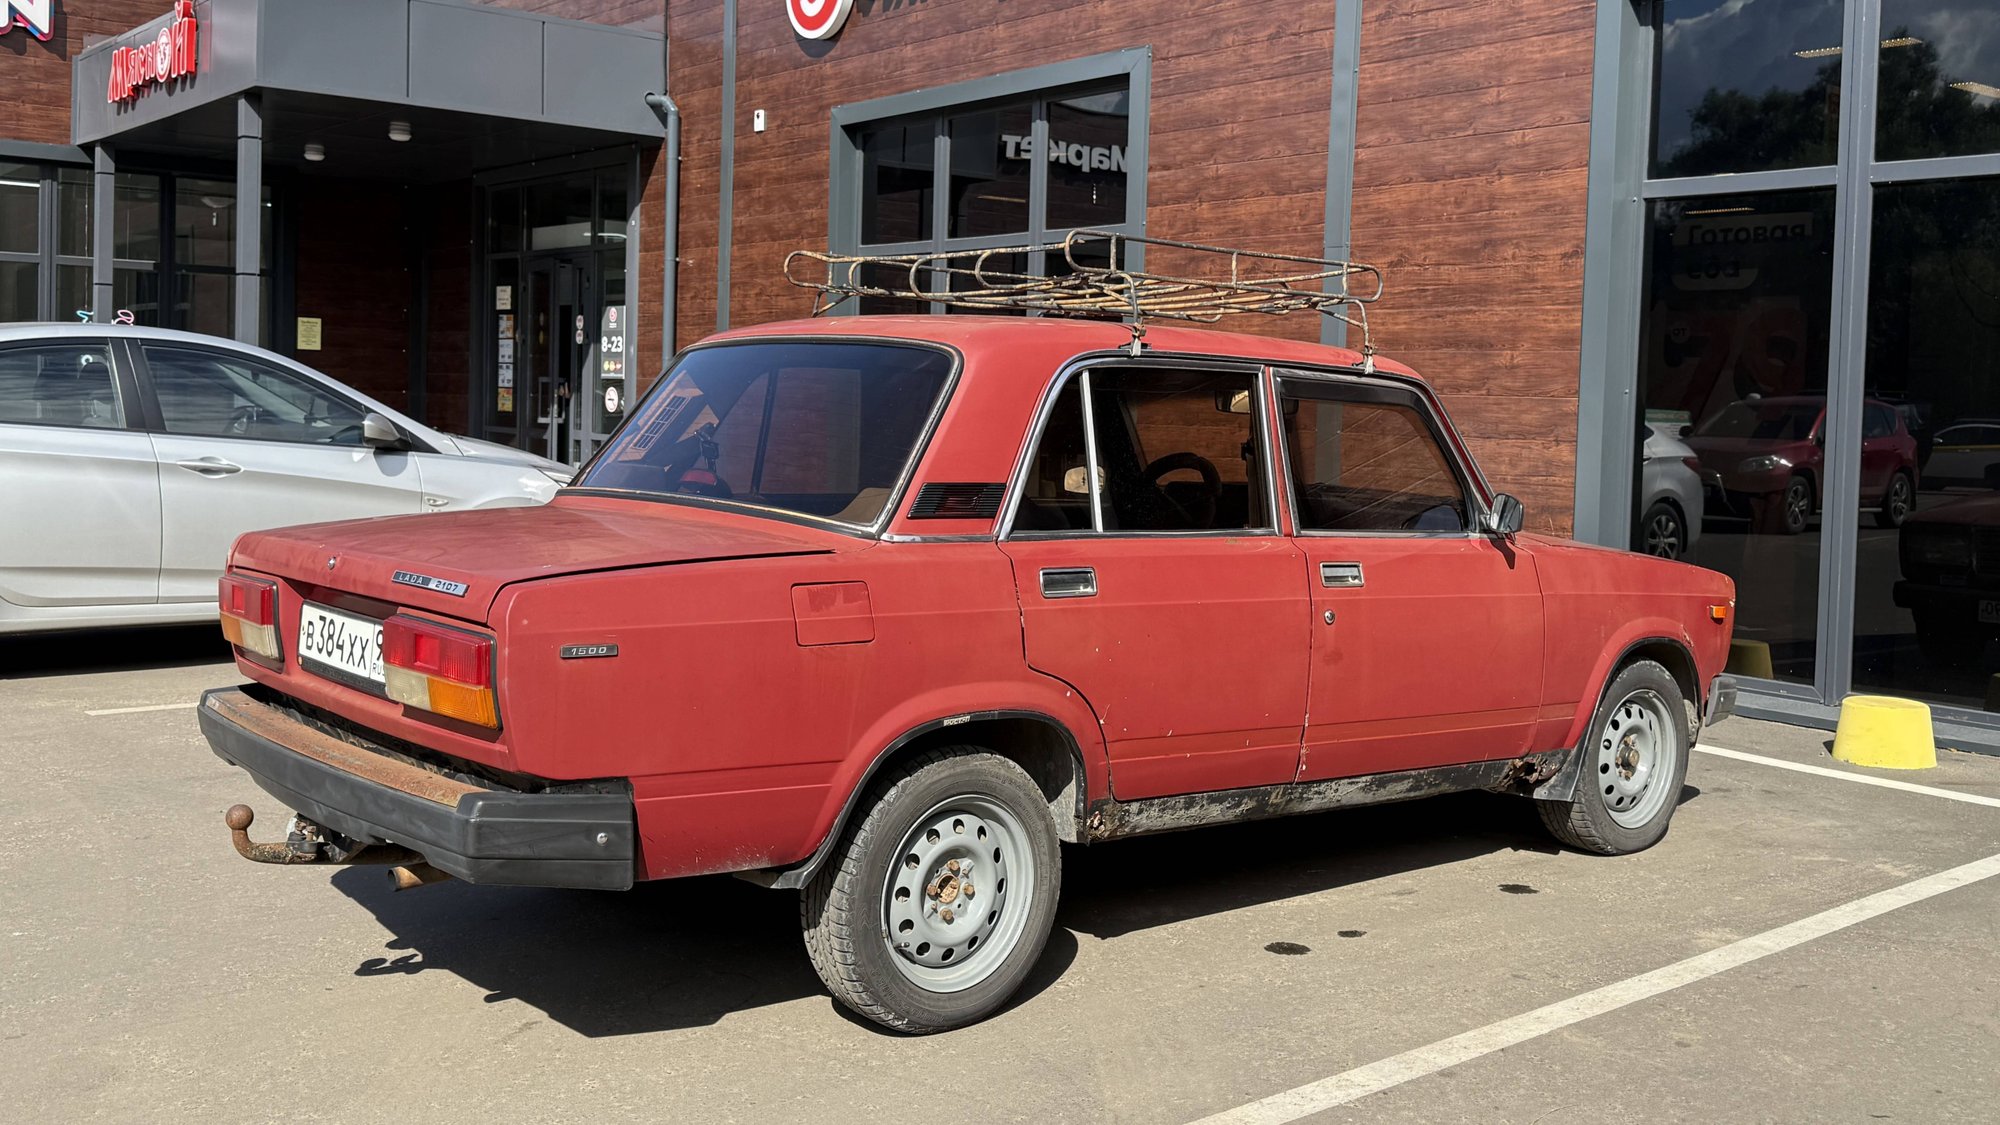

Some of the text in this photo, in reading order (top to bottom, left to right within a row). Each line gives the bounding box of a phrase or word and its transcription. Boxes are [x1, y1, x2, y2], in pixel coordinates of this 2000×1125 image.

[108, 0, 194, 103] Мясной
[601, 336, 623, 352] 8-23
[399, 573, 460, 592] LADA 2107
[376, 629, 384, 661] 9
[571, 646, 607, 656] 1500
[372, 662, 385, 676] RU
